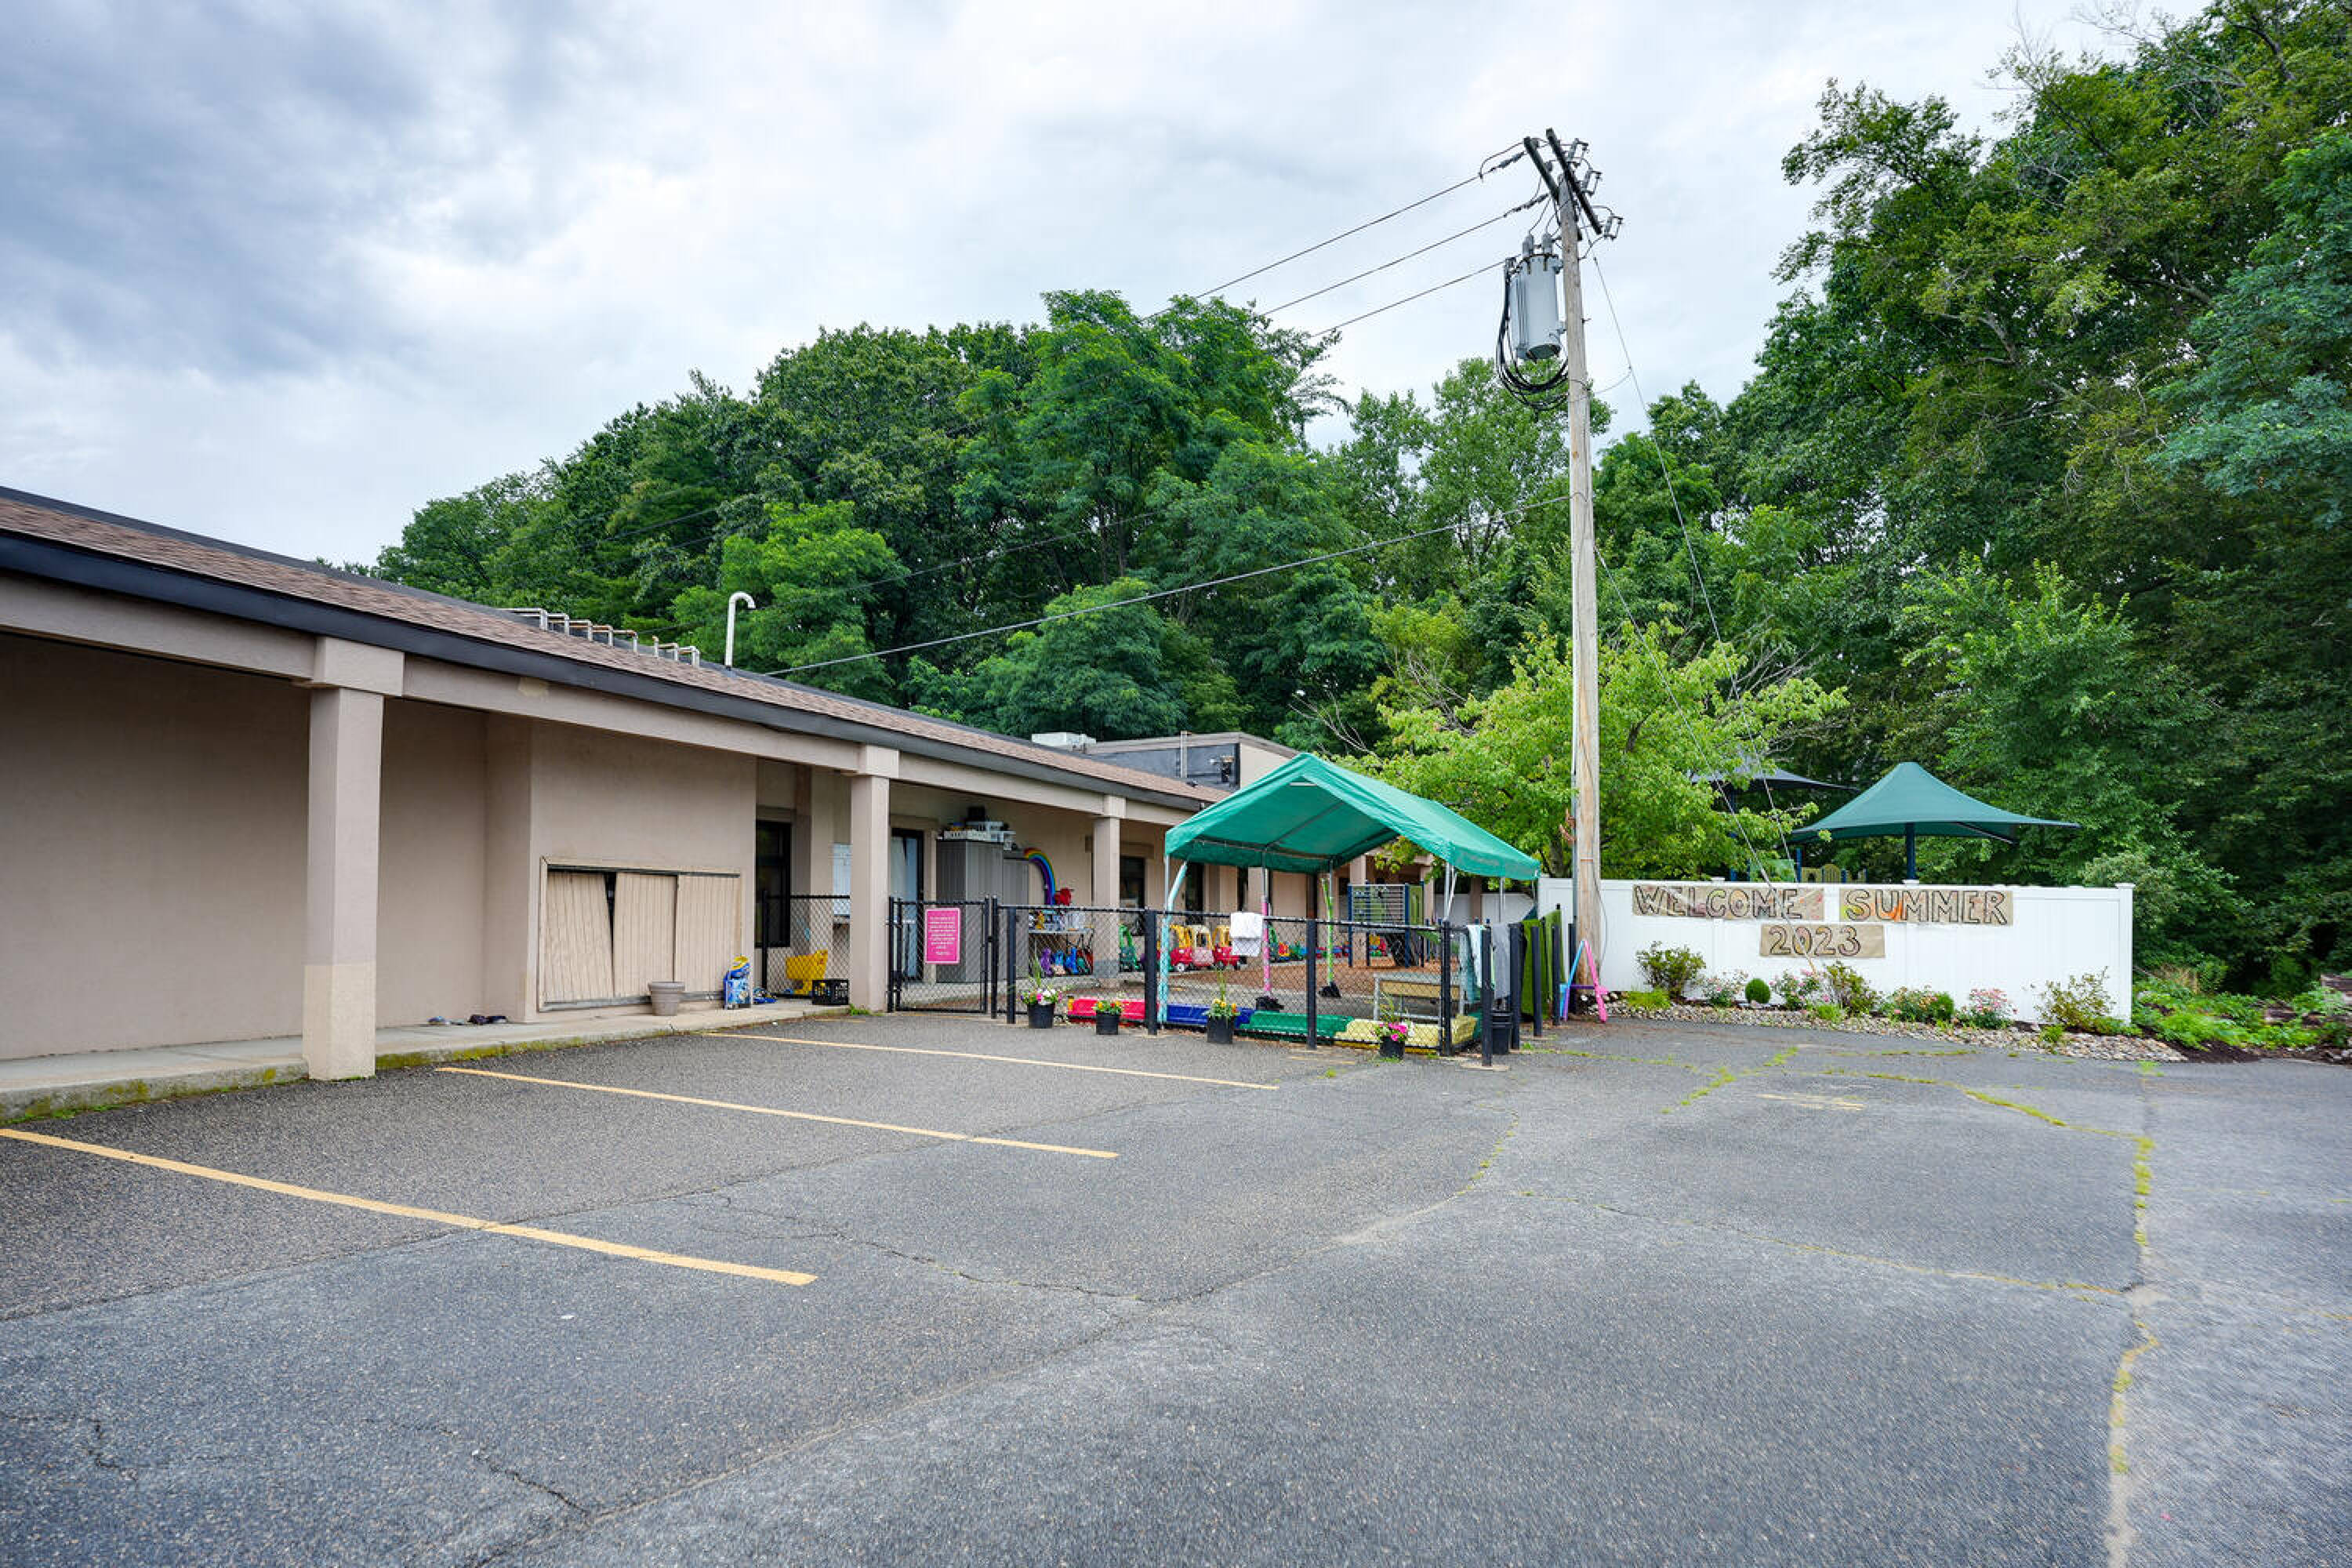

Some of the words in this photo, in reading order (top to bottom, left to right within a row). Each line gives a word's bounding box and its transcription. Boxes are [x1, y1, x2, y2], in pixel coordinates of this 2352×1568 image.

[1635, 884, 1802, 919] WELCOME
[1846, 888, 2008, 925] SUMMER
[1768, 924, 1862, 956] 2023
